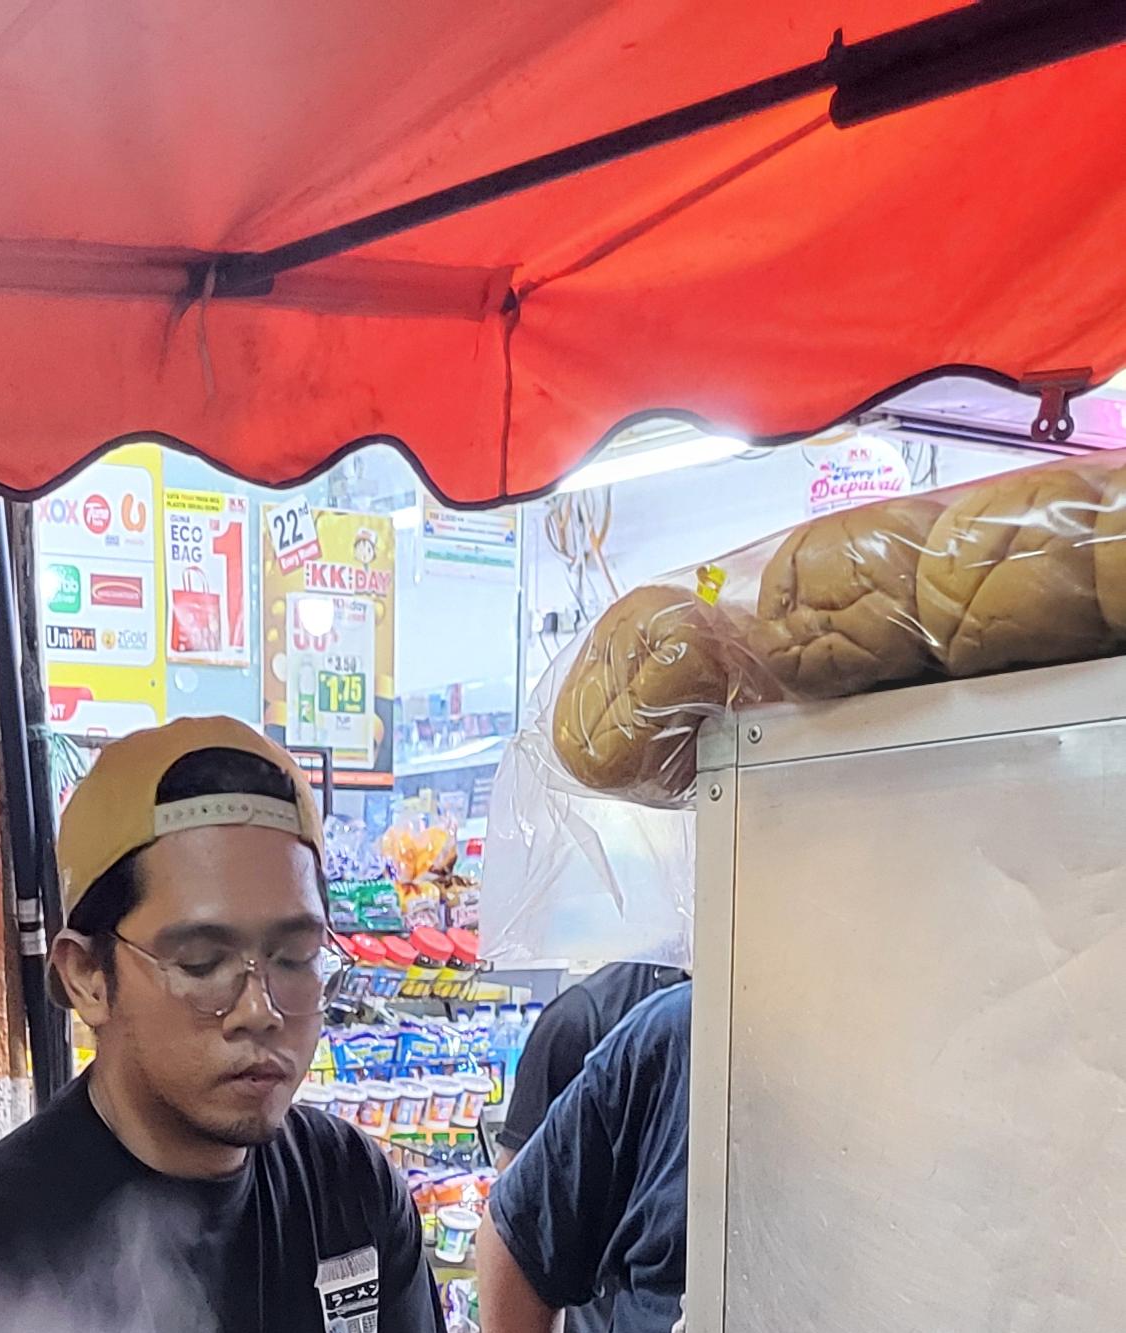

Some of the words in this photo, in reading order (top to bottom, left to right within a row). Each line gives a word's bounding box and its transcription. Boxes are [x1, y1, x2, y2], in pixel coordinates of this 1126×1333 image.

[810, 477, 904, 502] Deepavali
[39, 498, 79, 525] XOX
[170, 524, 203, 543] ECO
[273, 500, 310, 551] 22nd
[171, 544, 203, 563] BAG
[213, 521, 243, 647] 1
[310, 562, 348, 589] KK
[354, 568, 390, 592] DAY
[46, 626, 95, 650] UniPin
[331, 1283, 379, 1308] ラーメン
